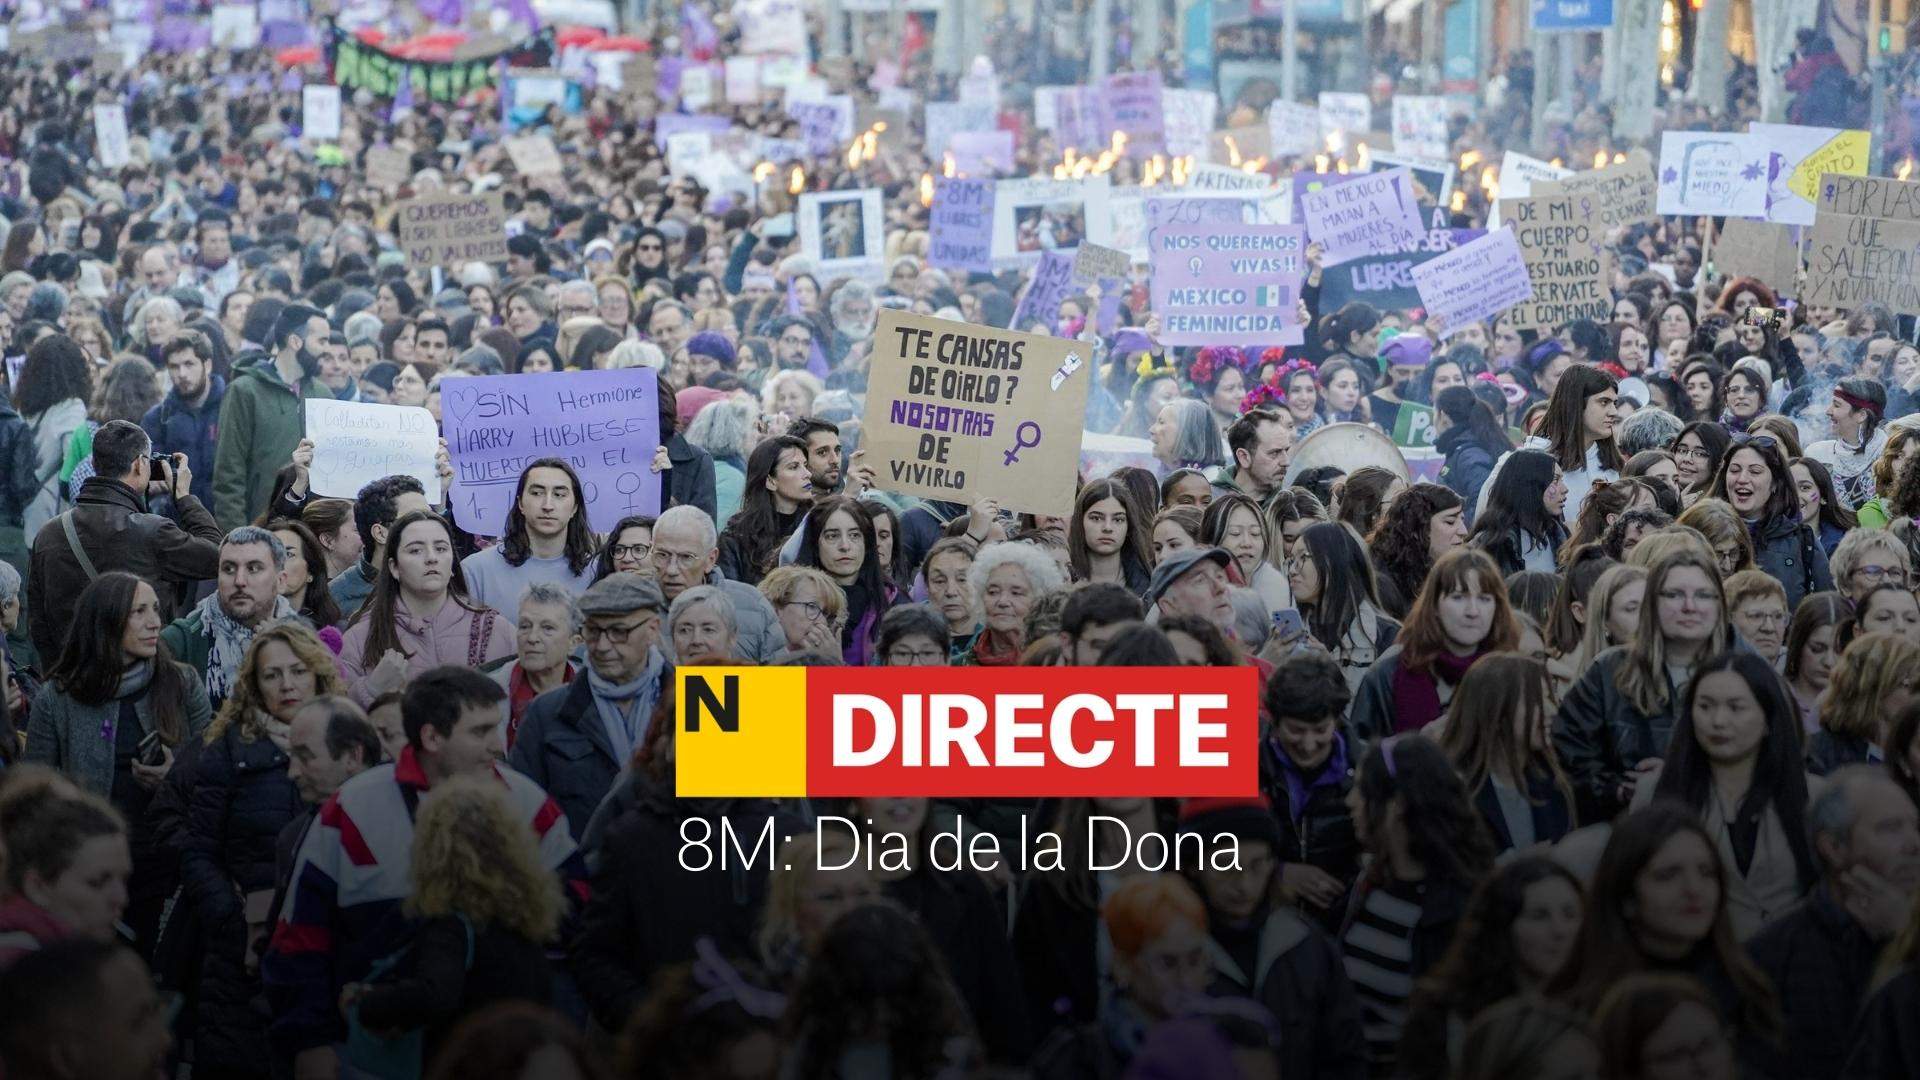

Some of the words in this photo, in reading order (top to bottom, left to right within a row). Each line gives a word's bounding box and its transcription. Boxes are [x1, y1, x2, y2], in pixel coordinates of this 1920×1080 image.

[947, 181, 983, 205] 8M
[1692, 181, 1730, 194] MIEDO
[1834, 177, 1879, 215] POR
[407, 200, 488, 222] QUEREMOS
[1309, 196, 1329, 213] EN
[1321, 204, 1364, 230] MATAN
[1369, 201, 1380, 216] A
[1518, 201, 1537, 221] DE
[1163, 235, 1201, 250] NOS
[1206, 235, 1297, 251] QUEREMOS
[1337, 217, 1394, 247] MUJERES
[1520, 224, 1589, 248] CUERPO
[1848, 217, 1889, 247] QUE
[411, 246, 432, 263] NO
[1817, 244, 1915, 283] SALIERON
[1168, 288, 1247, 306] MEXICO
[1811, 275, 1828, 299] Y
[1167, 315, 1282, 332] FEMINICIDA
[1512, 308, 1527, 325] EL
[895, 326, 933, 359] TE
[936, 333, 1026, 371] CANSAS
[908, 365, 939, 396] DE
[558, 386, 642, 412] Hermione
[399, 411, 425, 432] NO
[890, 399, 995, 437] NOSOTRAS
[456, 427, 514, 454] HARRY
[534, 418, 646, 448] HUBIESE
[603, 447, 631, 466] EL
[917, 433, 951, 464] DE
